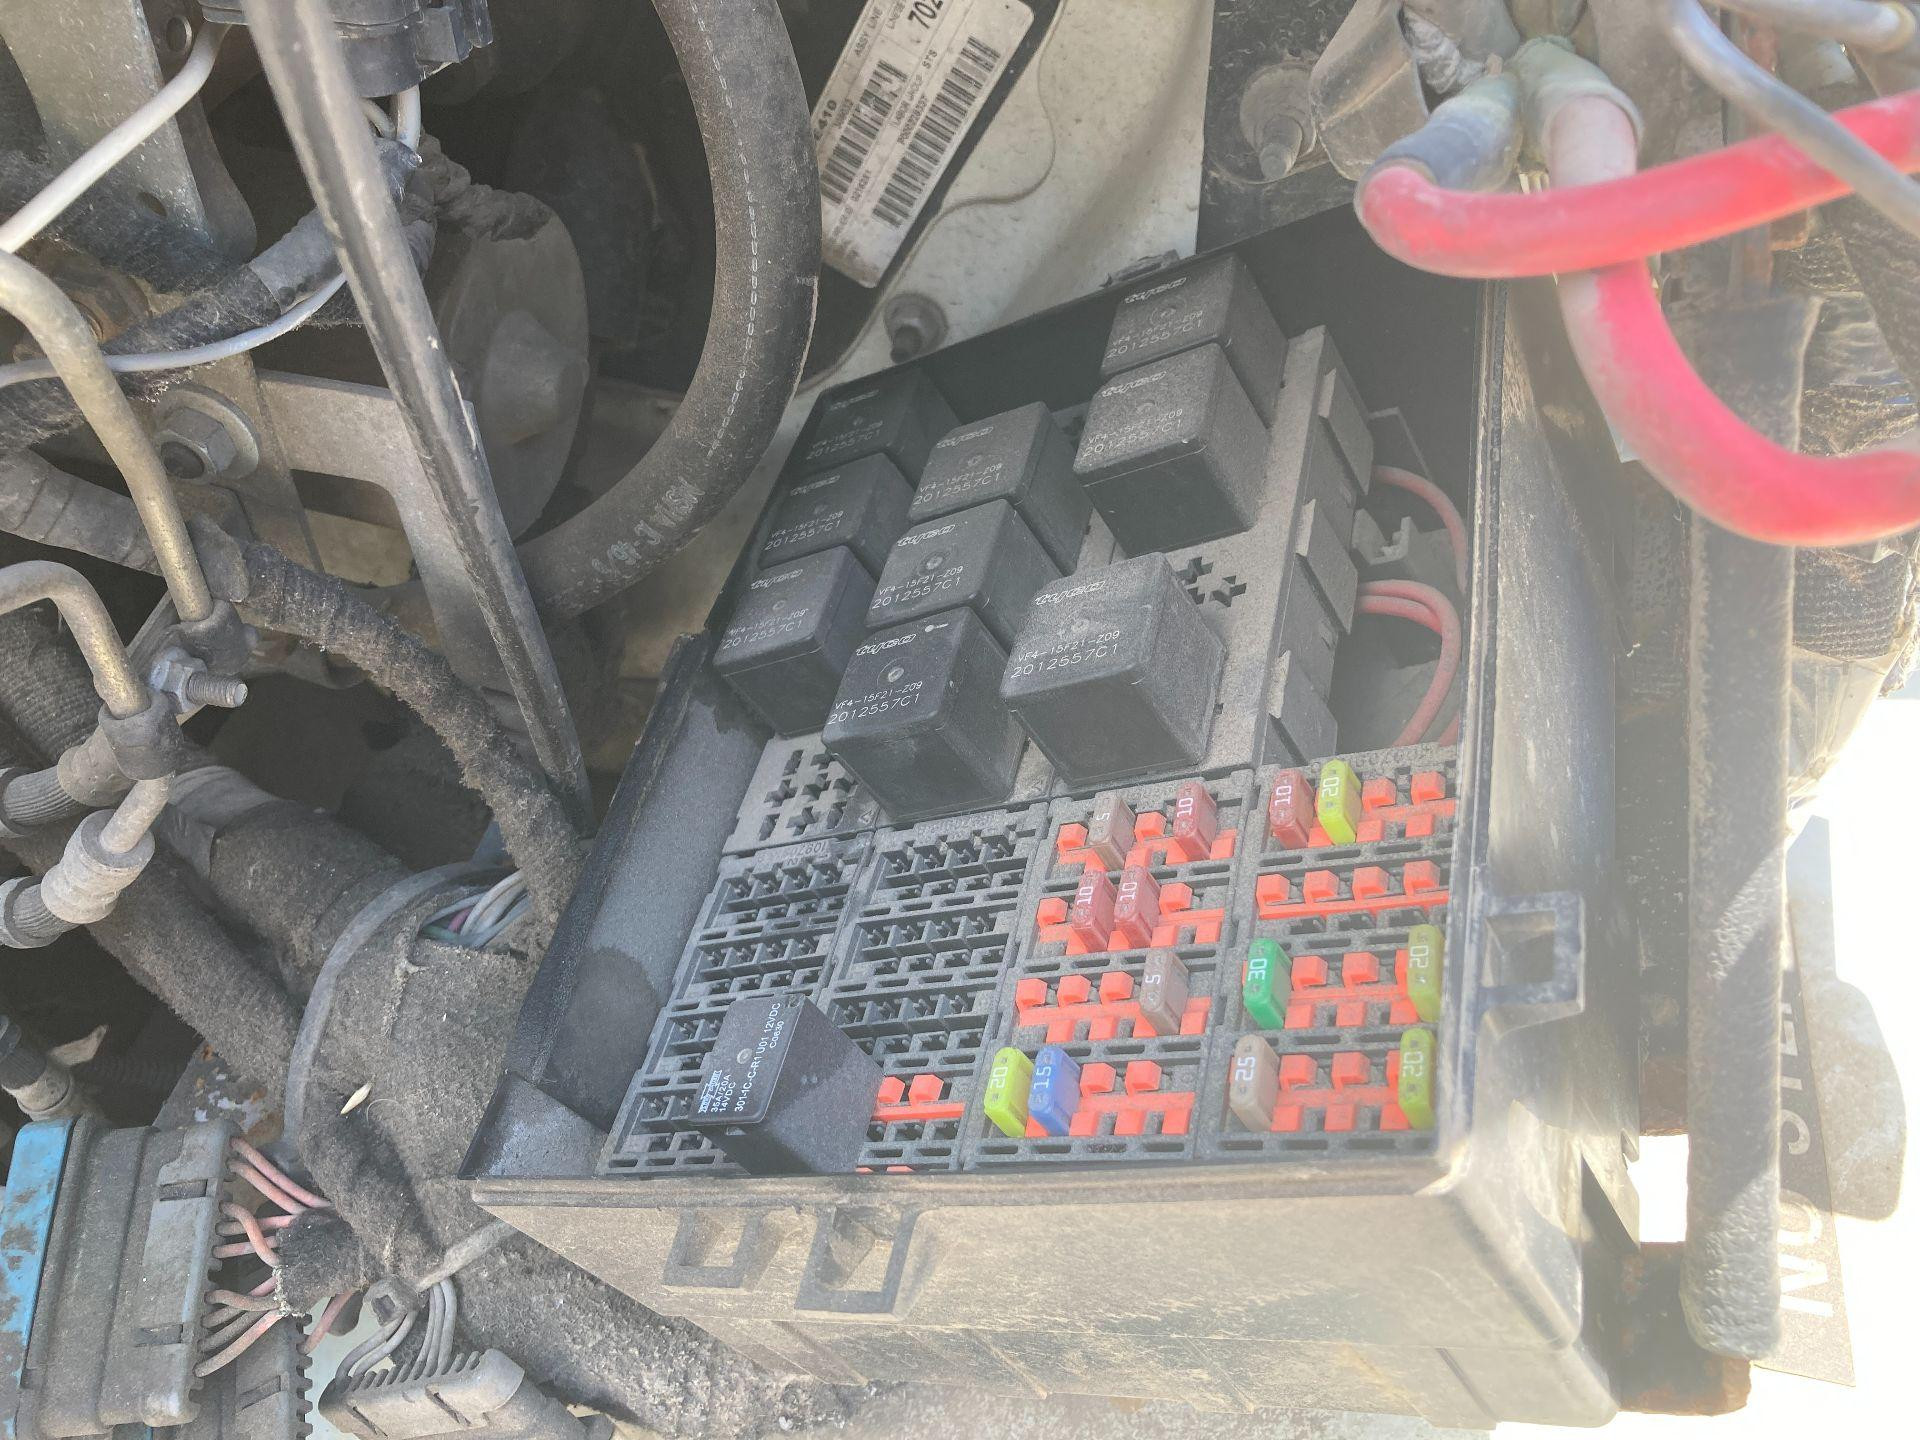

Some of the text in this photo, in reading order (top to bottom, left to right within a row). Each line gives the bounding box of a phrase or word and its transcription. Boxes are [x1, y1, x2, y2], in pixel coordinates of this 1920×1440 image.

[764, 520, 841, 551] 2012557C1
[871, 577, 961, 610] 2012557C1
[722, 620, 802, 650] 2012557C1
[1010, 643, 1118, 679] 2012557C1
[826, 693, 920, 725] 2012557C1
[1275, 785, 1292, 806] 10
[1321, 776, 1340, 799] 20
[1096, 812, 1111, 821] 5
[1176, 797, 1194, 818] 10
[1077, 886, 1094, 906] 10
[1120, 881, 1138, 901] 10
[1409, 944, 1430, 968] 20
[1144, 974, 1161, 985] 5
[1247, 957, 1268, 981] 30
[763, 1002, 781, 1033] 12VDC
[1234, 1056, 1256, 1081] 25
[1402, 1051, 1424, 1078] 20
[989, 1066, 1009, 1089] 20
[1033, 1066, 1052, 1090] 15
[719, 1081, 737, 1113] 14VDC
